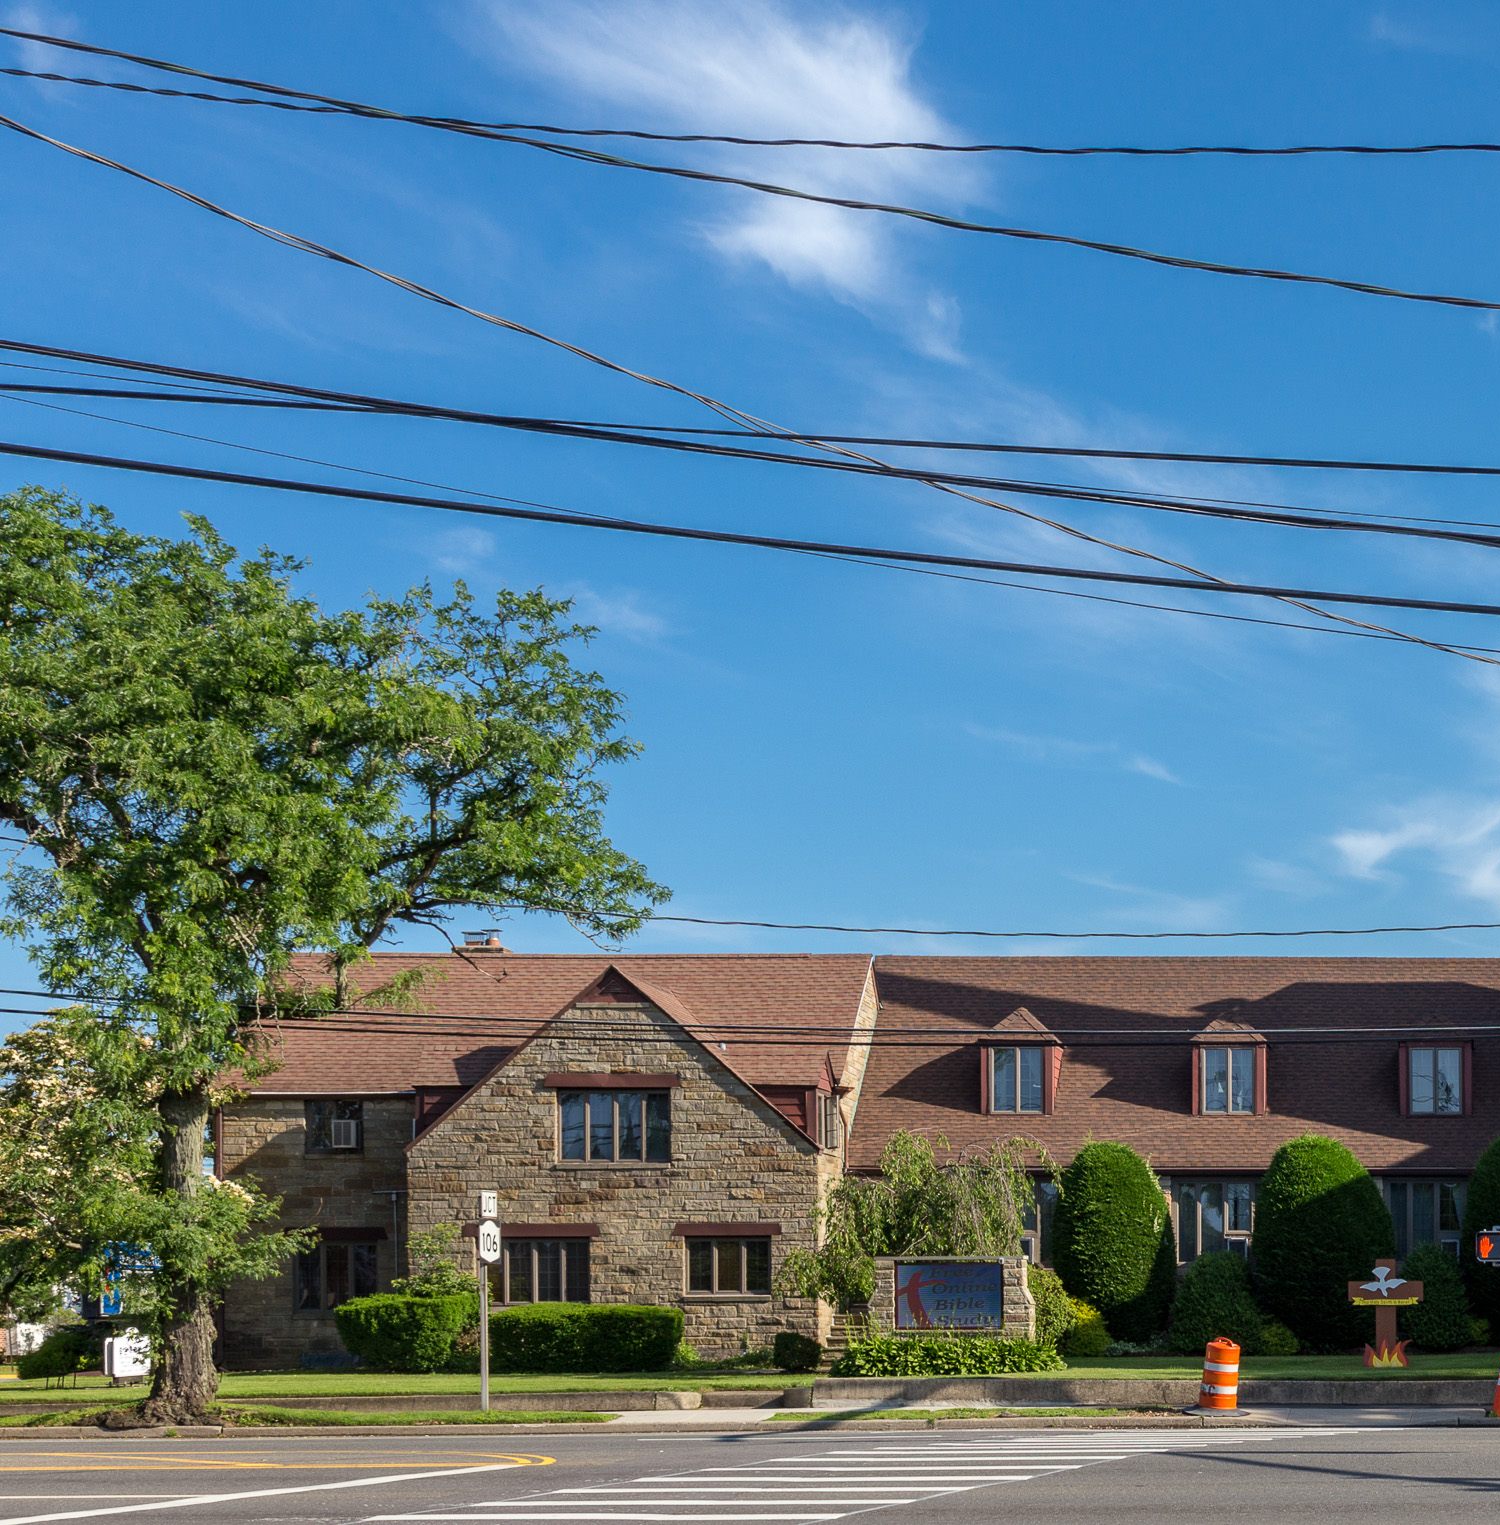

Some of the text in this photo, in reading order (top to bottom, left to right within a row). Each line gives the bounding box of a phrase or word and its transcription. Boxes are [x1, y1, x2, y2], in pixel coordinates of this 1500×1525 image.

[483, 1196, 496, 1213] JCT
[482, 1233, 498, 1252] 106
[929, 1267, 974, 1279] Free
[931, 1281, 998, 1295] Online
[935, 1297, 985, 1311] Bible
[937, 1313, 995, 1327] Study
